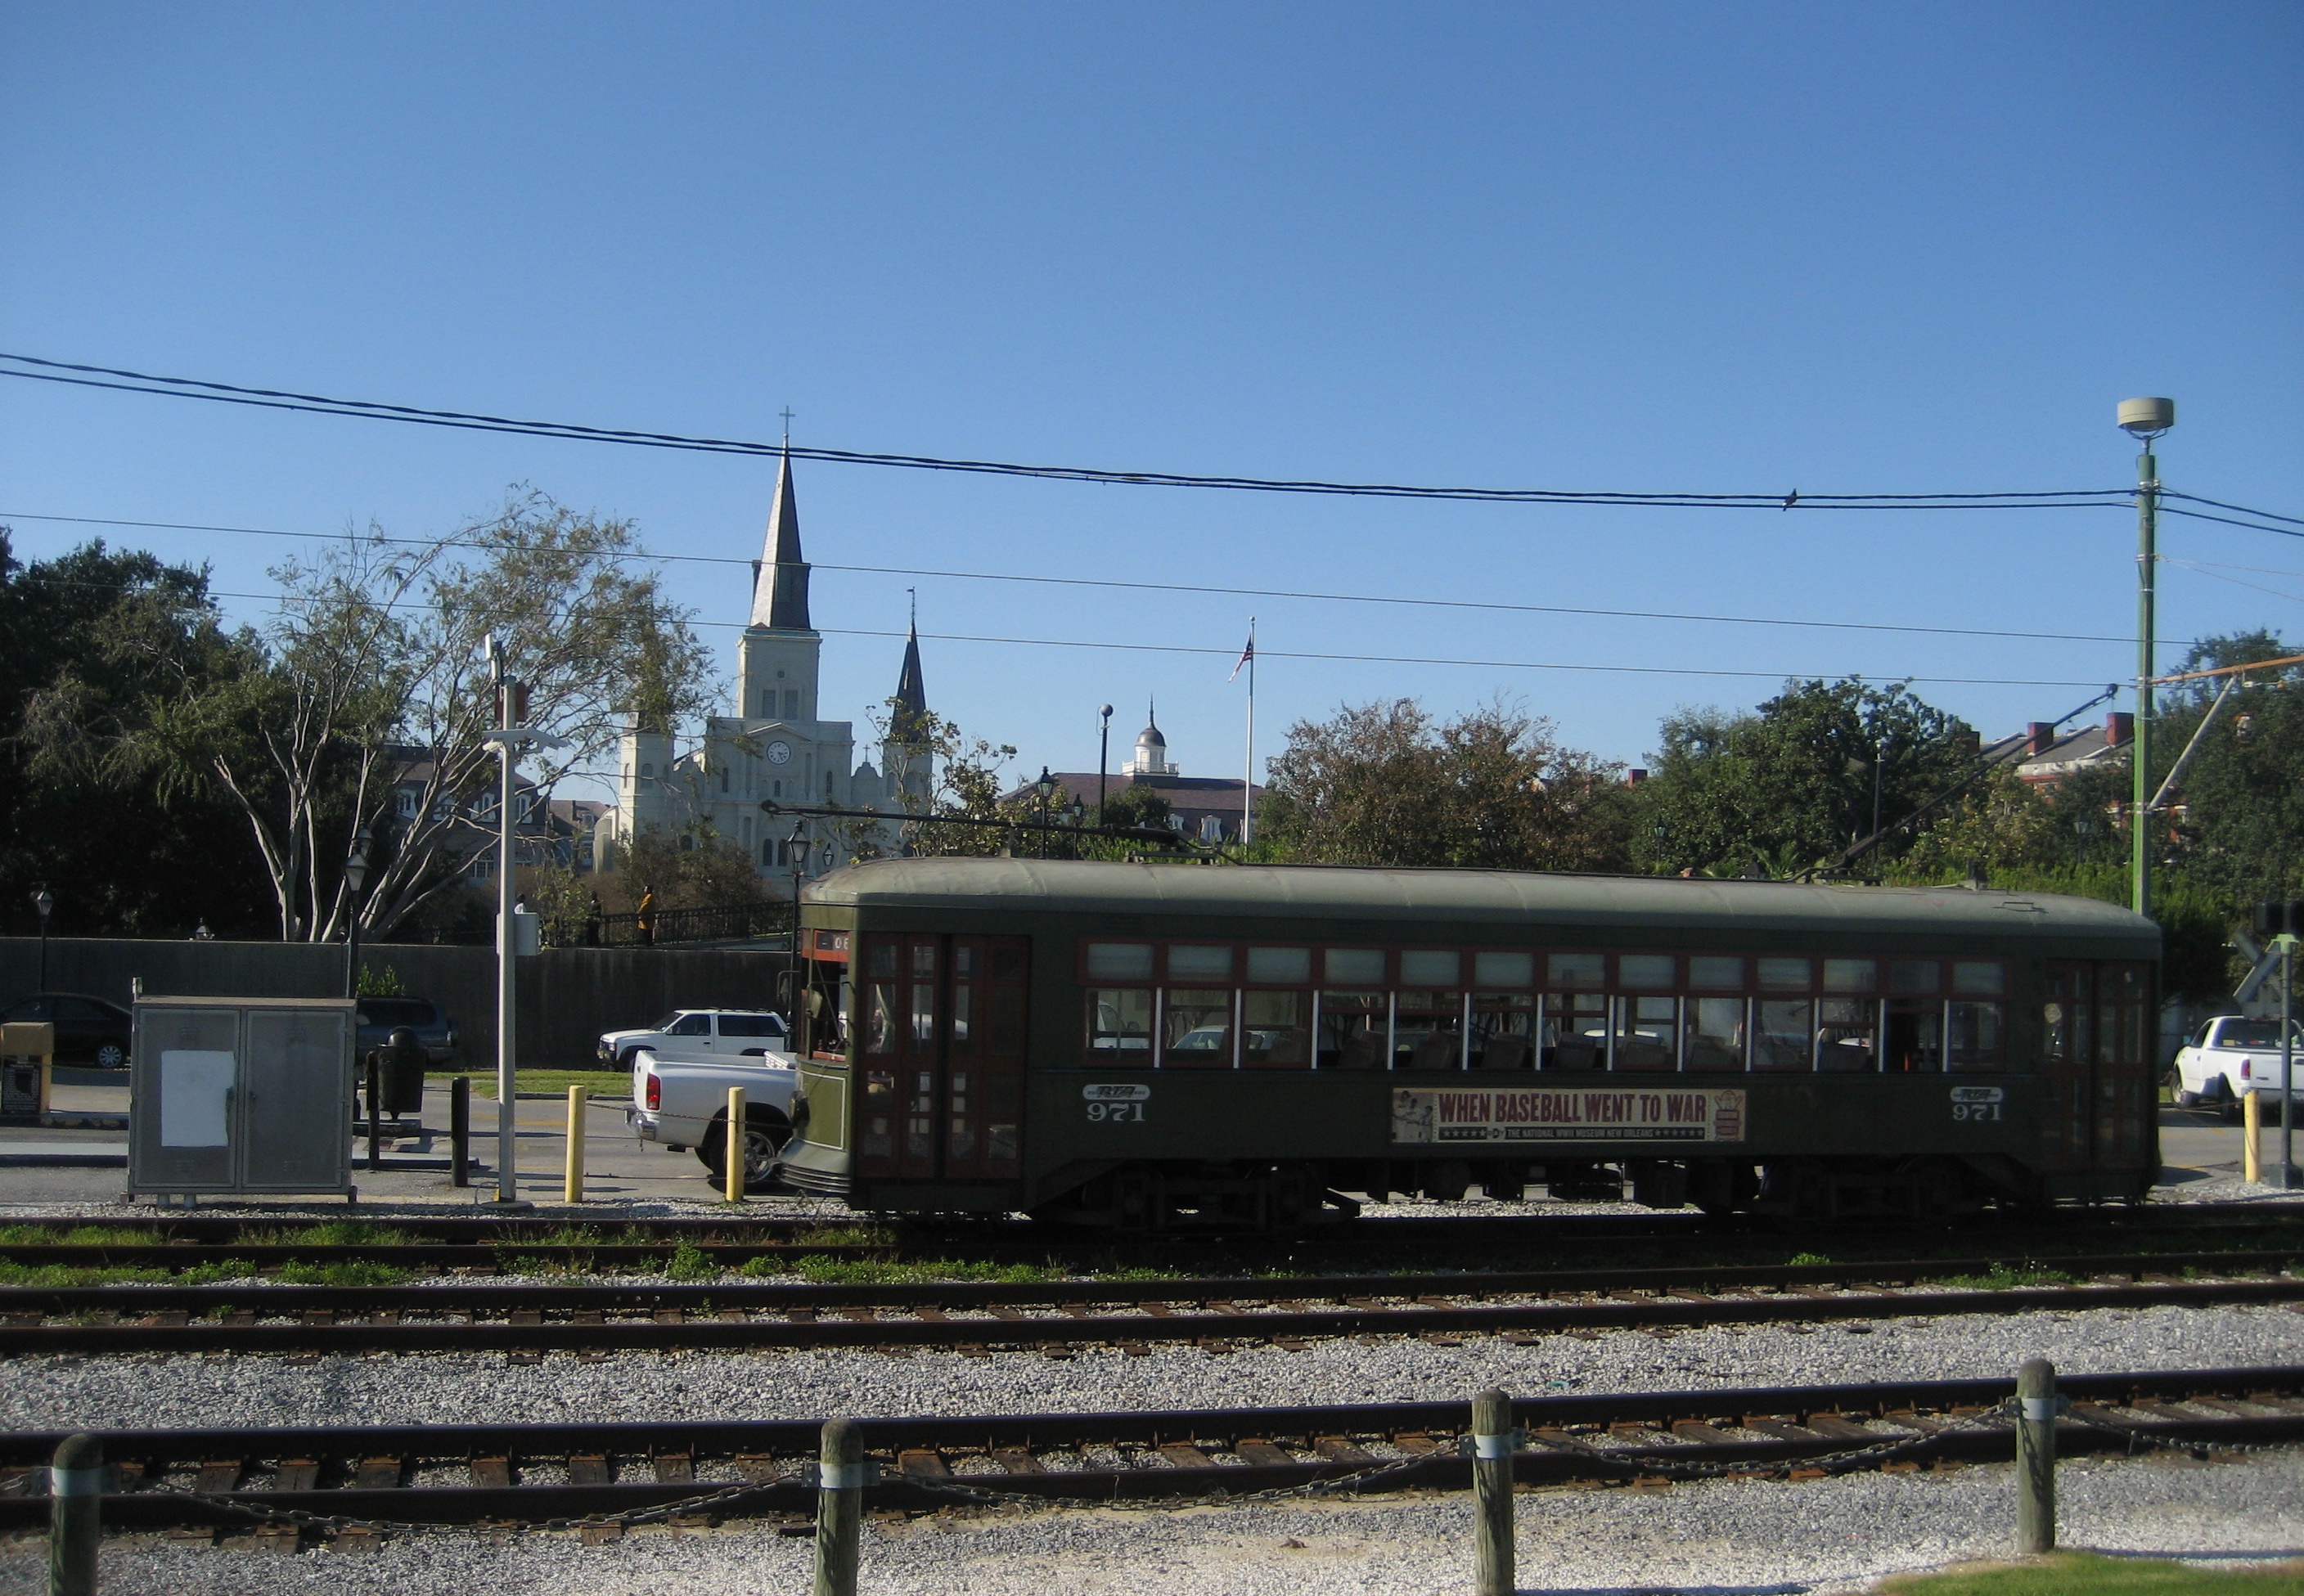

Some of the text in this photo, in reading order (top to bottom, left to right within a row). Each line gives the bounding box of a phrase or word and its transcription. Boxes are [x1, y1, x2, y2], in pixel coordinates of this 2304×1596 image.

[1086, 1103, 1146, 1122] 971
[1438, 1093, 1707, 1122] WHEN BASEBALL WENT TO WAR
[1952, 1104, 2002, 1121] 971
[1507, 1129, 1521, 1138] THE
[1576, 1129, 1605, 1138] MUSEUM
[1607, 1129, 1622, 1138] NEW
[1623, 1129, 1654, 1138] ORLEANS
